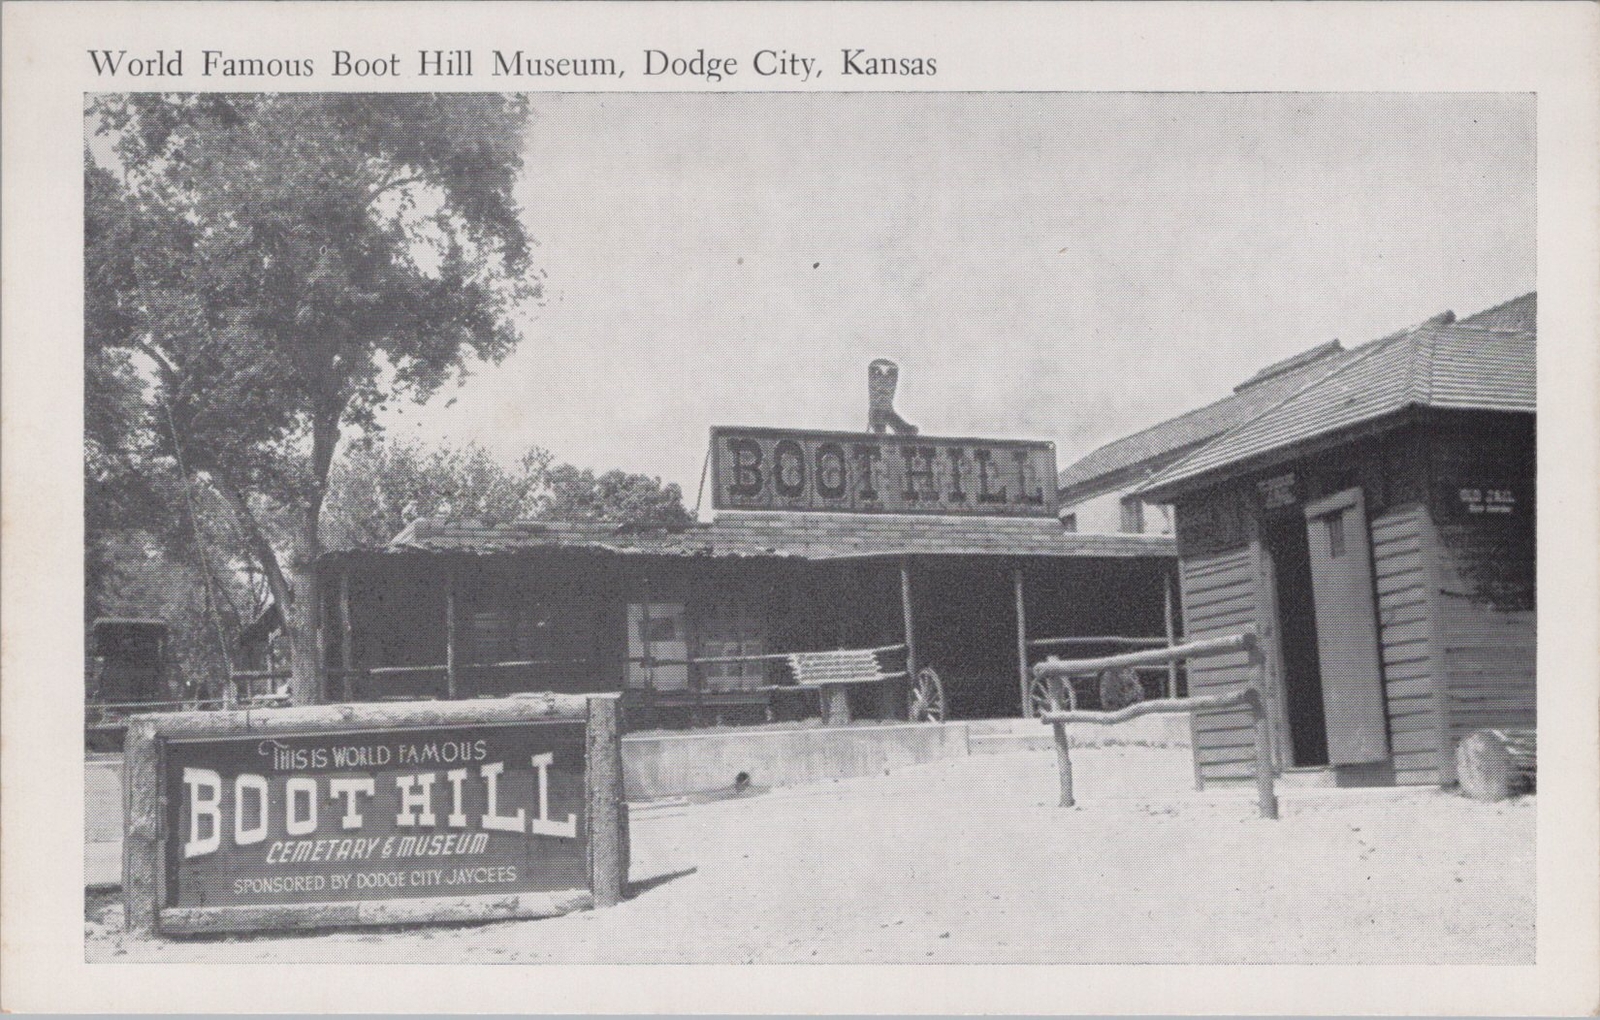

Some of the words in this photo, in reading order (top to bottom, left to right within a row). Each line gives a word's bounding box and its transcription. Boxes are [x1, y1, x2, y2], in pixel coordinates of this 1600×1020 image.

[725, 437, 882, 501] BOOT
[901, 446, 1044, 505] HILL
[311, 749, 328, 768] IS
[332, 745, 391, 768] WORLD
[399, 740, 488, 764] FAMOUS
[183, 767, 375, 859] BOOT
[395, 751, 577, 839] HILL
[265, 837, 380, 864] CEMETARY
[397, 833, 490, 857] MUSEUM
[233, 875, 325, 895] SPONSORED
[330, 874, 352, 890] BY
[356, 870, 405, 889] DODGE
[410, 870, 442, 886] CITY
[446, 866, 518, 884] JAYCEES
